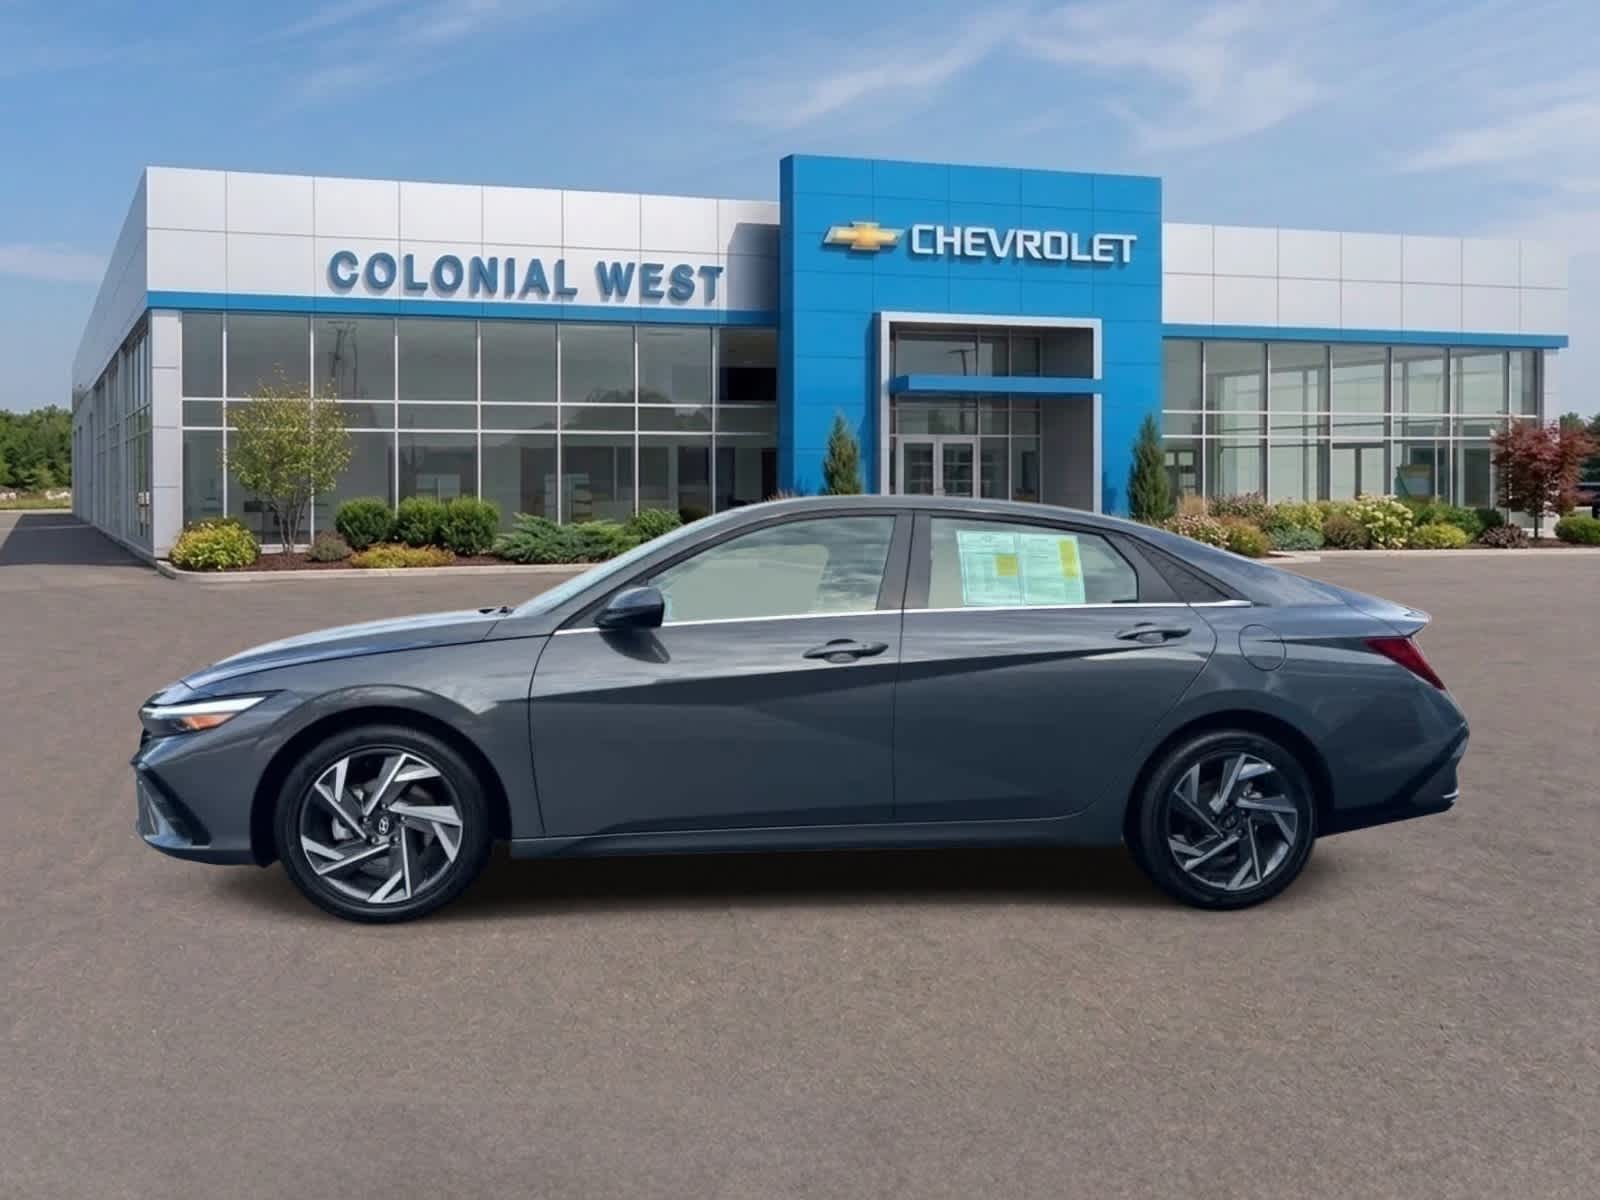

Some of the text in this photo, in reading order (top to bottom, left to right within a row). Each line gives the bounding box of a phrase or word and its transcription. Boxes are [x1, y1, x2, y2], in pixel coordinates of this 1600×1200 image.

[911, 223, 1137, 263] CHEVROLET
[328, 250, 724, 303] COLONIAL WEST
